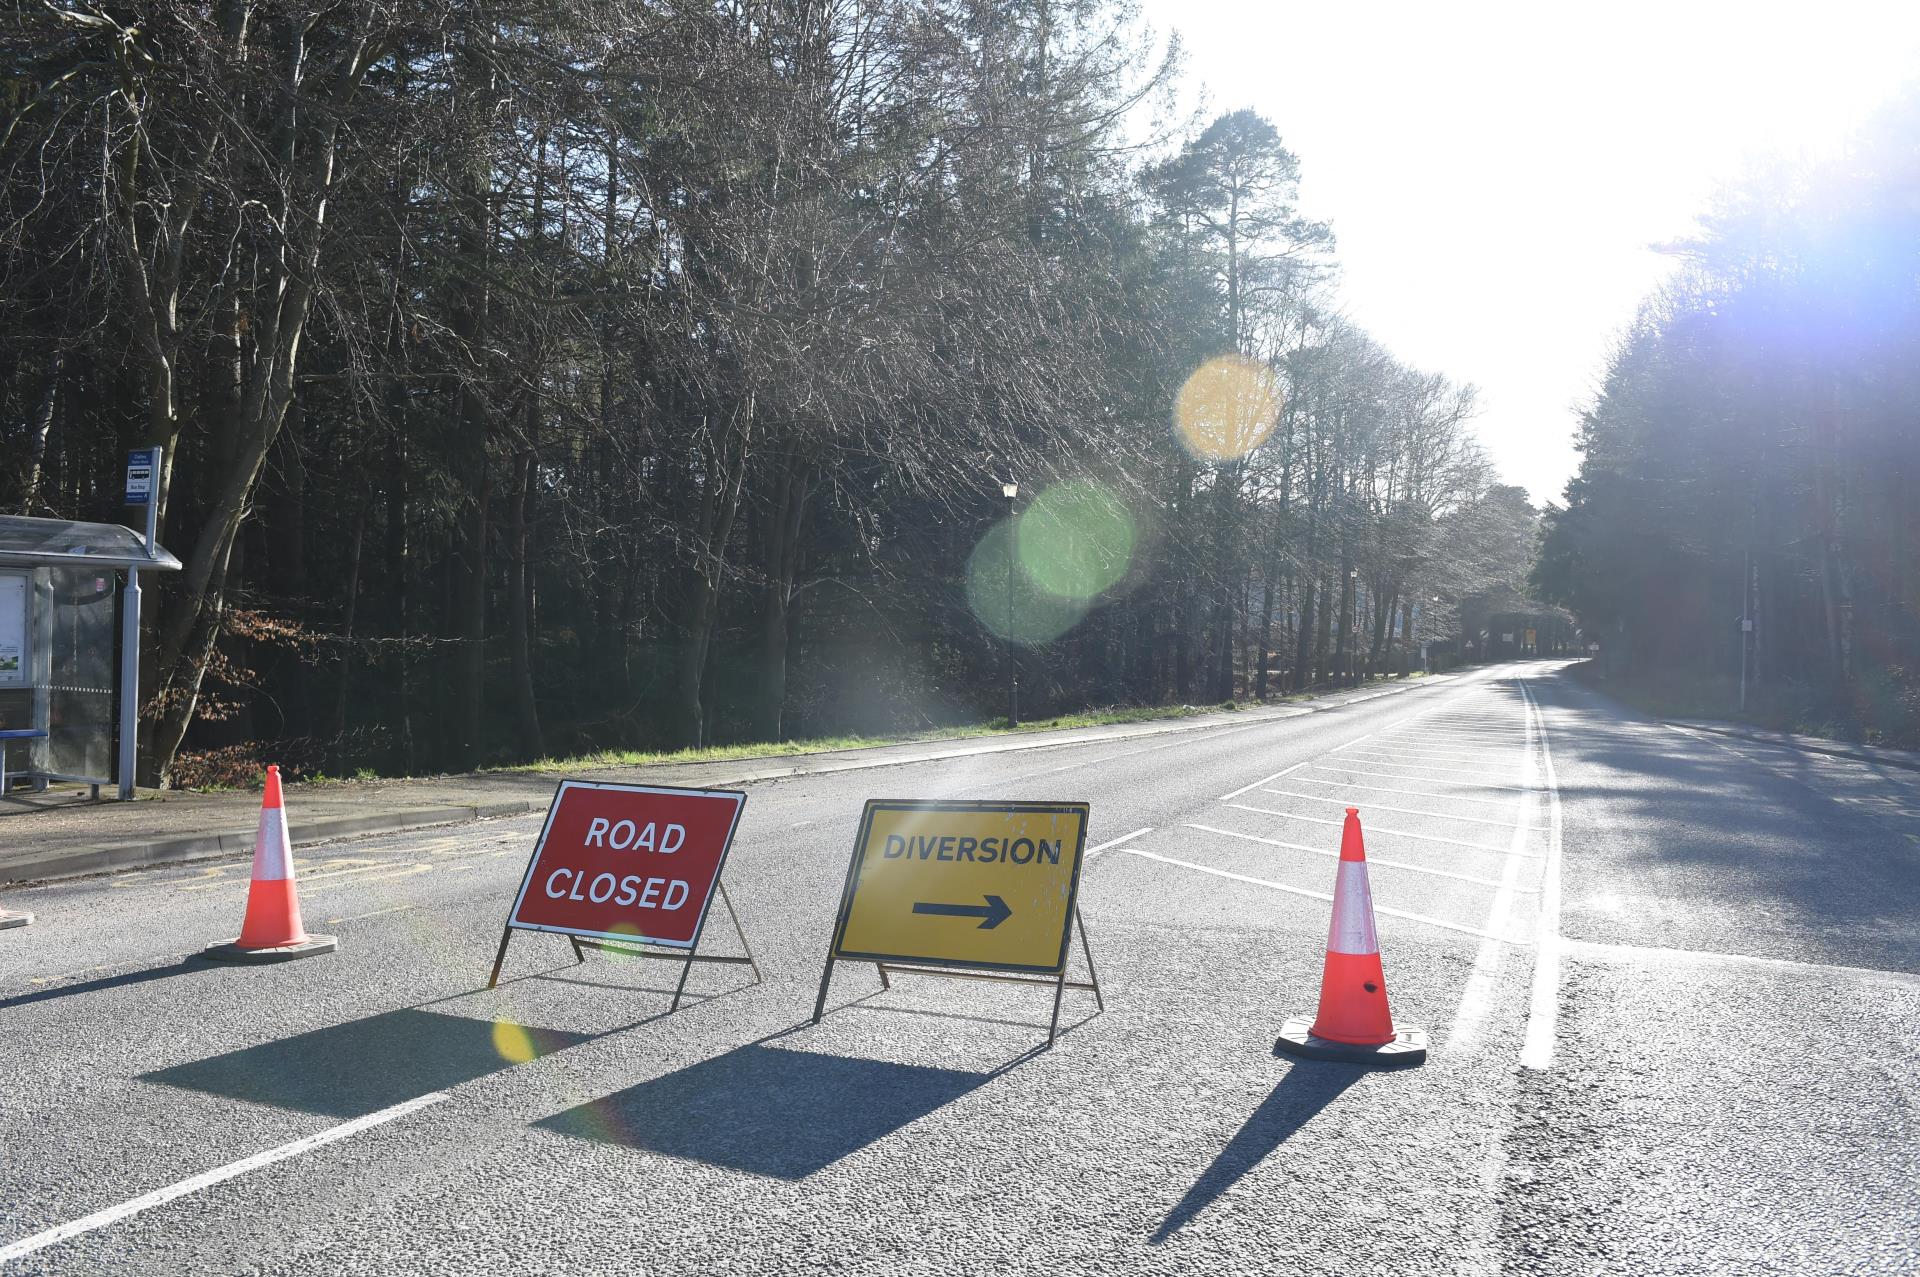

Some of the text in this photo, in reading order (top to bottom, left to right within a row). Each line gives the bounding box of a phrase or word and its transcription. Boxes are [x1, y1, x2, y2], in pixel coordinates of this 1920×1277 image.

[584, 817, 686, 854] ROAD
[883, 834, 1062, 865] DIVERSION
[545, 868, 690, 911] CLOSED
